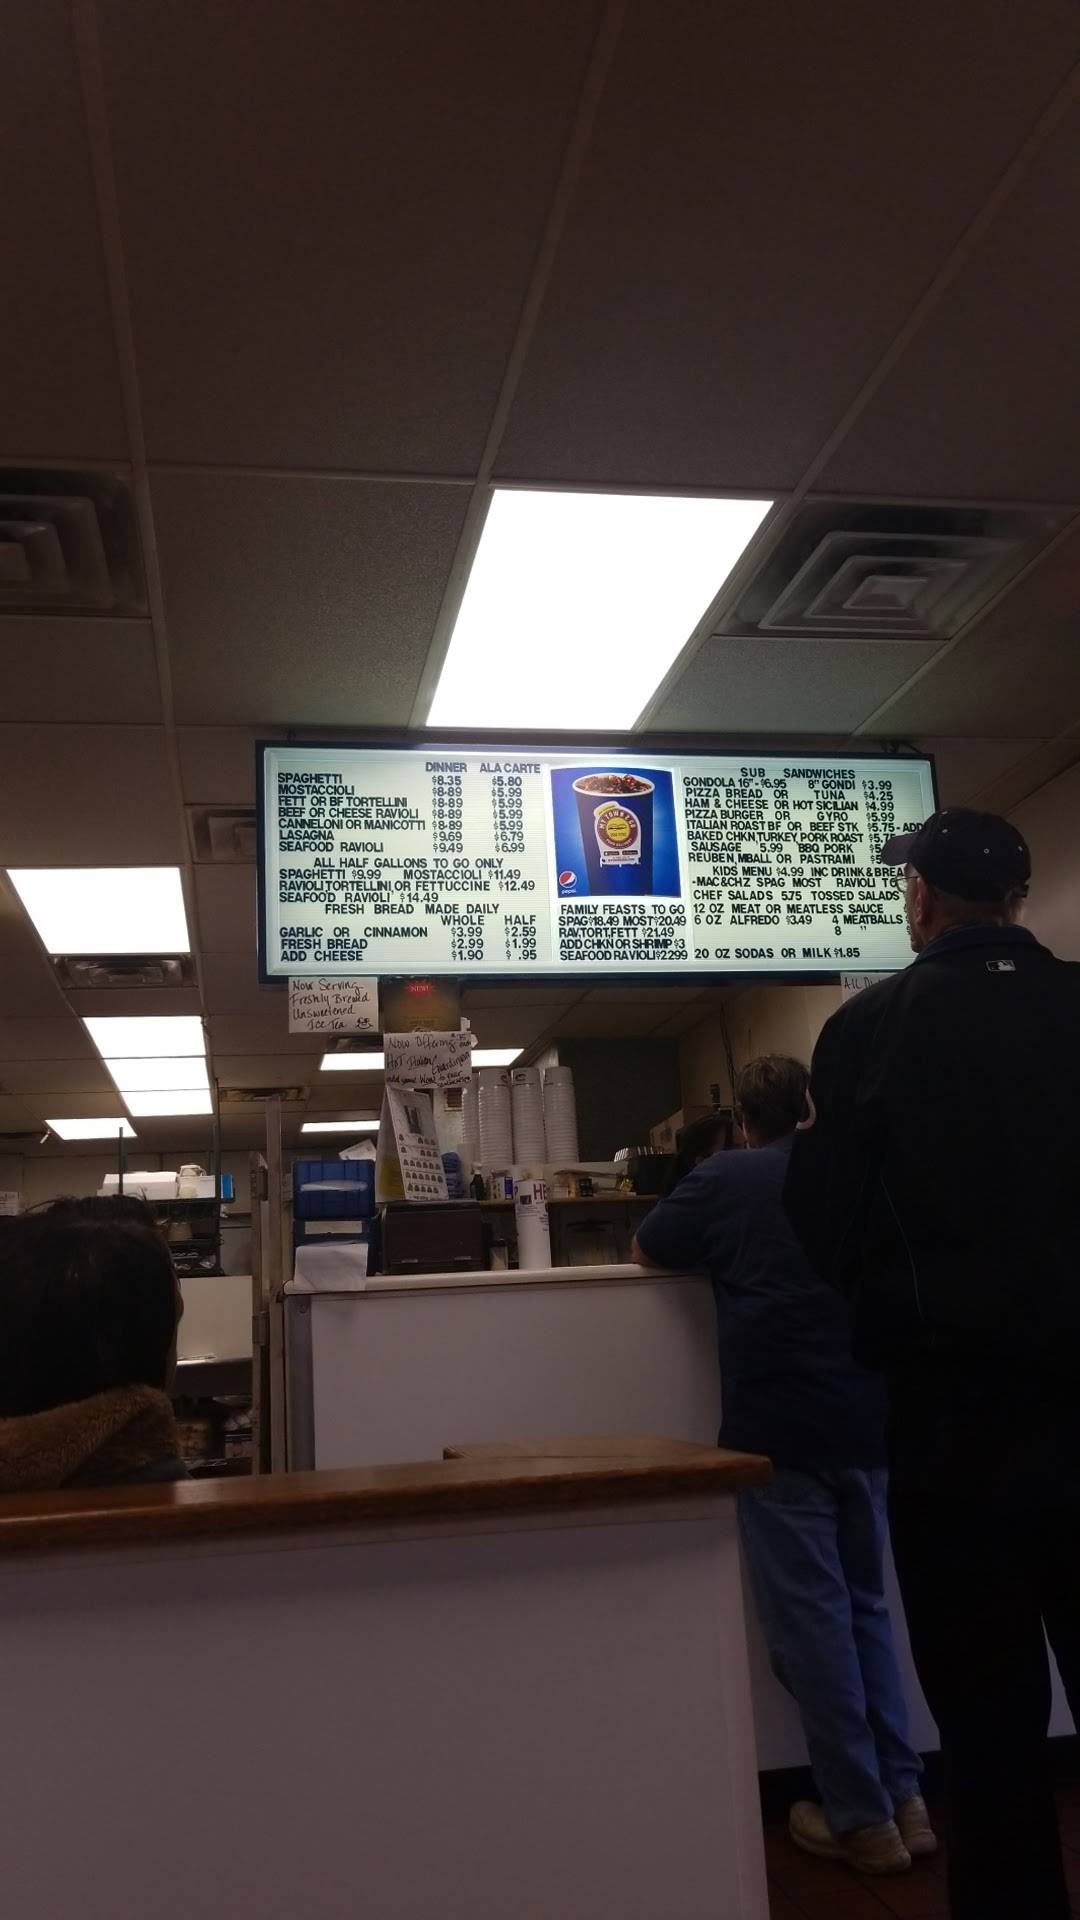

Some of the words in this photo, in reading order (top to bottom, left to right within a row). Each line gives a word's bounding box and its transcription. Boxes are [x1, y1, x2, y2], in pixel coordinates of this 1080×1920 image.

[425, 762, 468, 773] DINNER
[503, 763, 541, 774] CARTE
[740, 767, 766, 778] SUB
[783, 768, 856, 779] SANDWICHES
[278, 773, 342, 784] SPAGHETTI
[432, 775, 462, 786] $8.35
[491, 776, 522, 787] $5.80
[683, 777, 736, 788] GONDOLA
[761, 778, 787, 789] $6.95
[821, 780, 856, 790] GONDI
[862, 780, 892, 790] $3.99
[278, 784, 355, 796] MOSTACCIOLI
[491, 787, 522, 798] $5.99
[686, 787, 720, 798] PIZZA
[725, 788, 763, 799] BREAD
[773, 789, 789, 800] OR
[814, 790, 846, 800] TUNA
[863, 791, 894, 801] $4.25
[278, 796, 306, 806] FETT
[310, 796, 327, 807] OR
[329, 797, 343, 807] BF
[346, 797, 407, 807] TORTELLINI
[492, 798, 523, 809] $5.99
[685, 798, 710, 809] HAM
[725, 799, 769, 809] CHEESE
[774, 800, 789, 810] OR
[793, 800, 814, 810] HOT
[816, 801, 859, 811] SICILIAN
[865, 801, 895, 811] $4.99
[279, 807, 306, 817] BEEF
[309, 807, 325, 818] OR
[329, 808, 372, 818] CHEESE
[376, 808, 418, 819] RAVIOLI
[493, 809, 523, 820] $5.99
[685, 809, 718, 819] PIZZA
[720, 809, 764, 820] BURGER
[775, 811, 791, 821] OR
[817, 812, 848, 821] GYRO
[866, 812, 895, 821] $5.99
[279, 818, 343, 829] CANNELONI
[345, 819, 362, 830] OR
[364, 820, 425, 830] MANICOTTI
[493, 820, 523, 831] $5.99
[686, 820, 728, 830] ITALIAN
[730, 820, 766, 831] ROAST
[768, 821, 782, 831] BF
[787, 821, 802, 831] OR
[810, 822, 835, 832] BEEF
[838, 822, 859, 832] STK
[280, 830, 335, 840] LASAGNA
[433, 831, 462, 842] $9.69
[494, 832, 524, 842] $6.79
[687, 831, 723, 841] BAKED
[831, 833, 863, 843] ROAST
[279, 841, 334, 852] SEAFOOD
[340, 842, 384, 853] RAVIOLI
[433, 842, 463, 853] $9.49
[494, 843, 525, 854] $6.99
[691, 841, 742, 852] SAUSAGE
[760, 842, 783, 853] 5.99
[798, 843, 820, 854] BBQ
[824, 844, 854, 854] PORK
[313, 857, 335, 868] ALL
[339, 857, 369, 868] HALF
[374, 857, 428, 868] GALLONS
[433, 858, 449, 868] TO
[453, 858, 470, 868] GO
[475, 858, 504, 868] ONLY
[776, 854, 792, 864] OR
[800, 854, 856, 864] PASTRAMI
[279, 869, 346, 880] SPAGHETTI
[352, 869, 382, 880] $9.99
[403, 869, 482, 880] MOSTACCIOLI
[488, 869, 521, 880] $11.49
[713, 866, 738, 876] KIDS
[742, 866, 772, 877] MENU
[776, 867, 804, 877] $4.99
[811, 867, 828, 877] INC
[415, 881, 491, 891] FETTUCCINE
[498, 880, 535, 891] $12.49
[757, 877, 786, 888] SPAG
[793, 878, 822, 888] MOST
[836, 878, 876, 888] RAVIOLI
[279, 892, 336, 903] SEAFOOD
[344, 892, 391, 903] RAVIOLI
[400, 892, 439, 903] $14.49
[693, 890, 723, 900] CHEF
[728, 890, 774, 901] SALADS
[811, 890, 855, 901] TOSSED
[858, 890, 900, 901] SALADS
[325, 904, 365, 915] FRESH
[374, 904, 414, 915] BREAD
[425, 904, 459, 914] MADE
[466, 904, 500, 914] DAILY
[560, 904, 599, 915] FAMILY
[603, 904, 646, 915] FEASTS
[652, 904, 666, 915] TO
[669, 904, 685, 915] GO
[693, 903, 706, 914] 12
[709, 903, 725, 914] OZ
[731, 904, 761, 914] MEAT
[765, 904, 782, 914] OR
[787, 904, 844, 914] MEATLESS
[849, 904, 884, 914] SAUCE
[441, 915, 485, 926] WHOLE
[504, 915, 537, 926] HALF
[694, 914, 702, 925] 6
[705, 914, 722, 925] OZ
[729, 915, 780, 925] ALFREDO
[832, 915, 839, 925] 4
[843, 915, 904, 925] MEATBALLS
[279, 927, 324, 938] GARLIC
[333, 927, 350, 938] OR
[364, 927, 428, 938] CINNAMON
[451, 927, 483, 938] $3.99
[505, 927, 537, 937] $2.59
[641, 927, 675, 938] $21.49
[834, 925, 842, 936] 8
[281, 939, 322, 950] FRESH
[327, 939, 368, 950] BREAD
[451, 938, 484, 949] $2.99
[505, 938, 537, 949] $1.99
[560, 939, 583, 950] ADD
[584, 939, 614, 950] CHKN
[615, 939, 632, 950] OR
[632, 939, 673, 949] SHRIMP
[674, 939, 686, 949] $3
[281, 951, 307, 962] ADD
[314, 951, 364, 961] CHEESE
[451, 950, 484, 961] $1.90
[560, 950, 612, 961] SEAFOOD
[694, 948, 710, 959] 20
[715, 948, 731, 959] OZ
[735, 948, 774, 958] SODAS
[781, 948, 796, 958] OR
[802, 948, 831, 958] MILK
[833, 948, 860, 958] $1.85
[292, 980, 313, 991] Now
[319, 977, 364, 996] Serving
[289, 992, 330, 1007] Freshly
